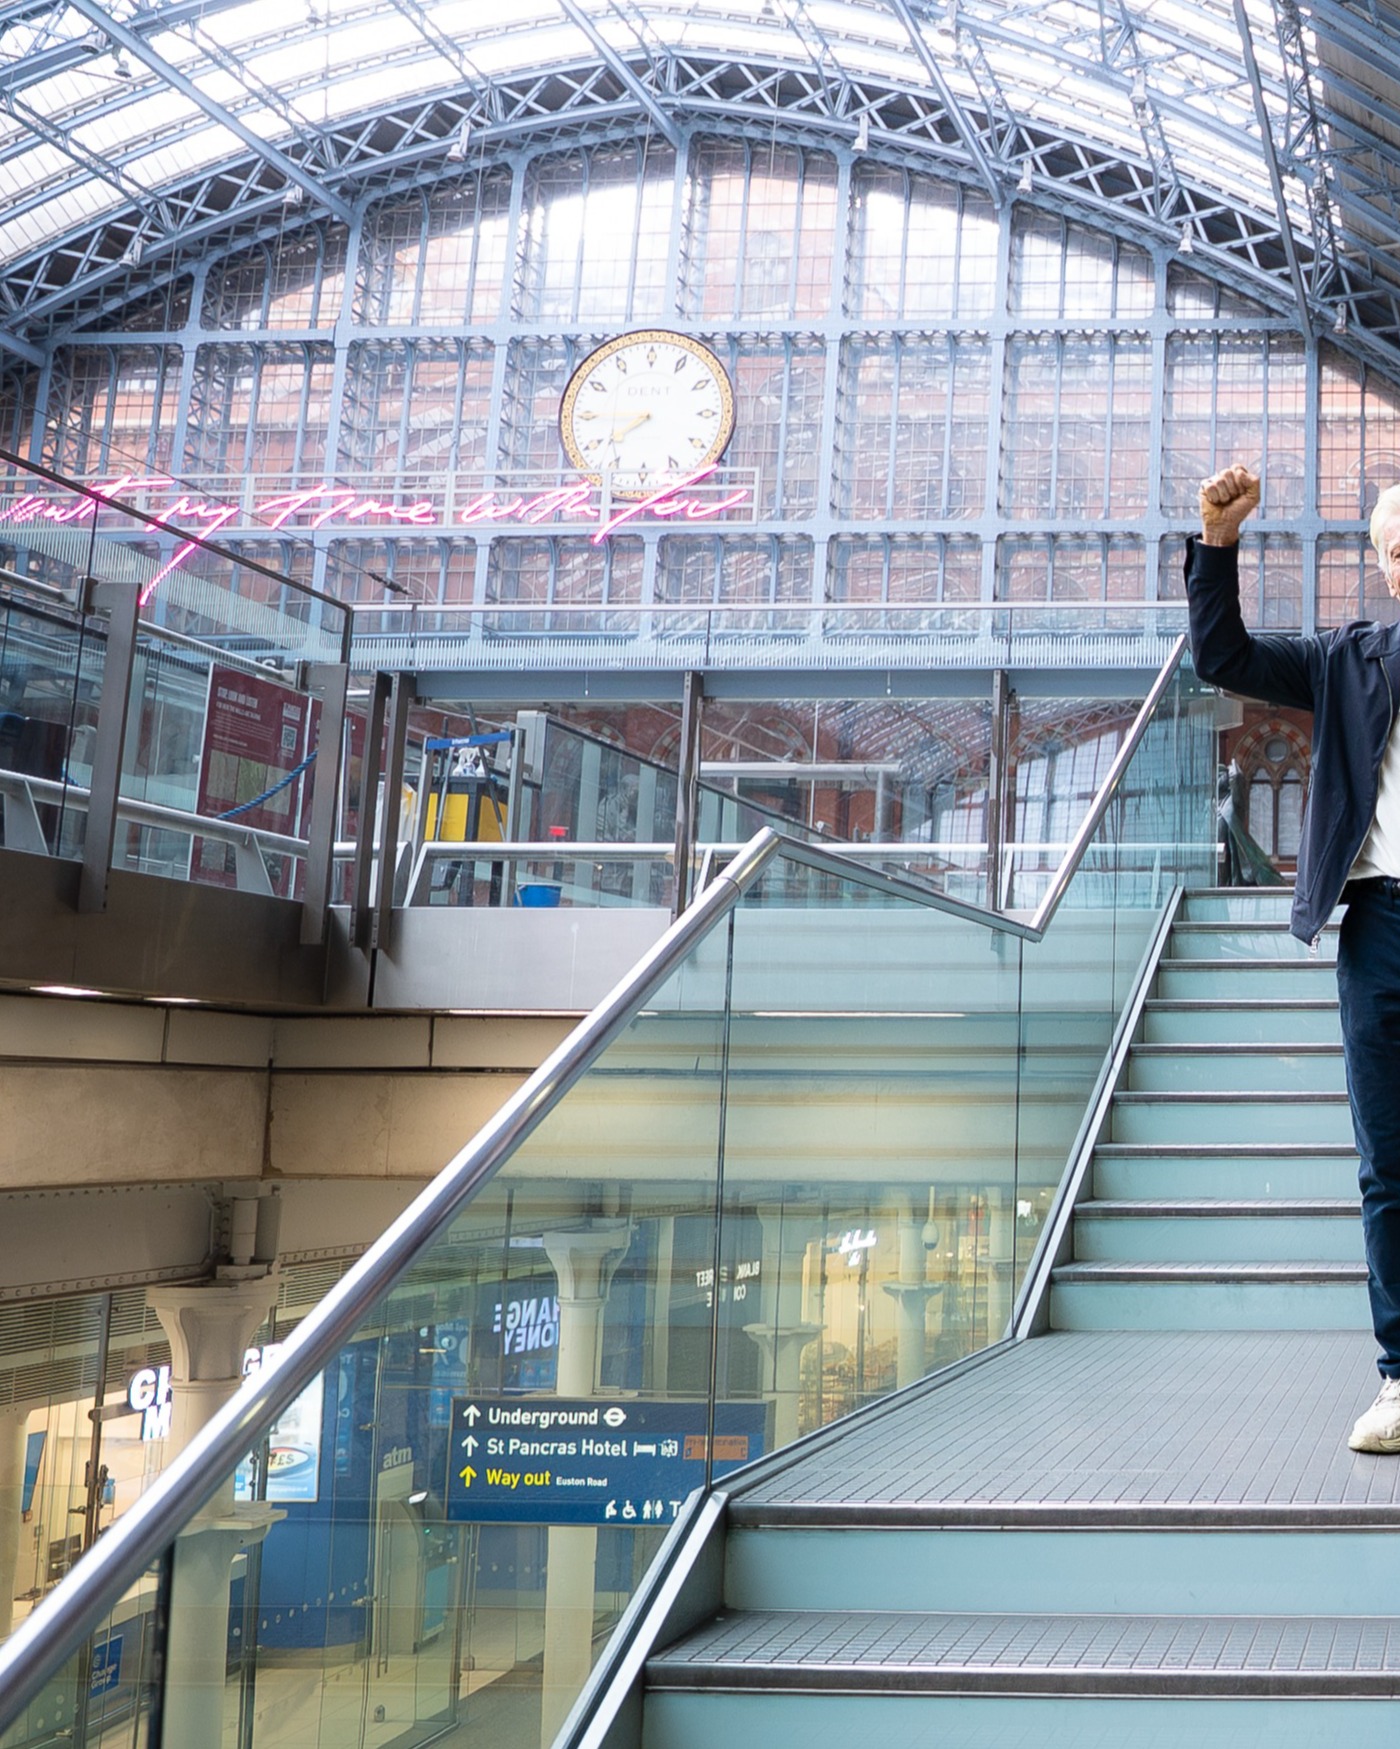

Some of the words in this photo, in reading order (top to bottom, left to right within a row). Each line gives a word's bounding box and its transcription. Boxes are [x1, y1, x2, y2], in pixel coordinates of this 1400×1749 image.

[627, 386, 671, 397] DENT
[488, 1407, 598, 1429] Underground
[382, 1446, 413, 1469] atm
[486, 1438, 505, 1456] St
[508, 1438, 577, 1456] Pancras
[581, 1438, 628, 1457] Hotel
[486, 1468, 521, 1489] Way
[524, 1470, 551, 1486] out
[556, 1475, 586, 1486] Euston
[586, 1476, 608, 1488] Road
